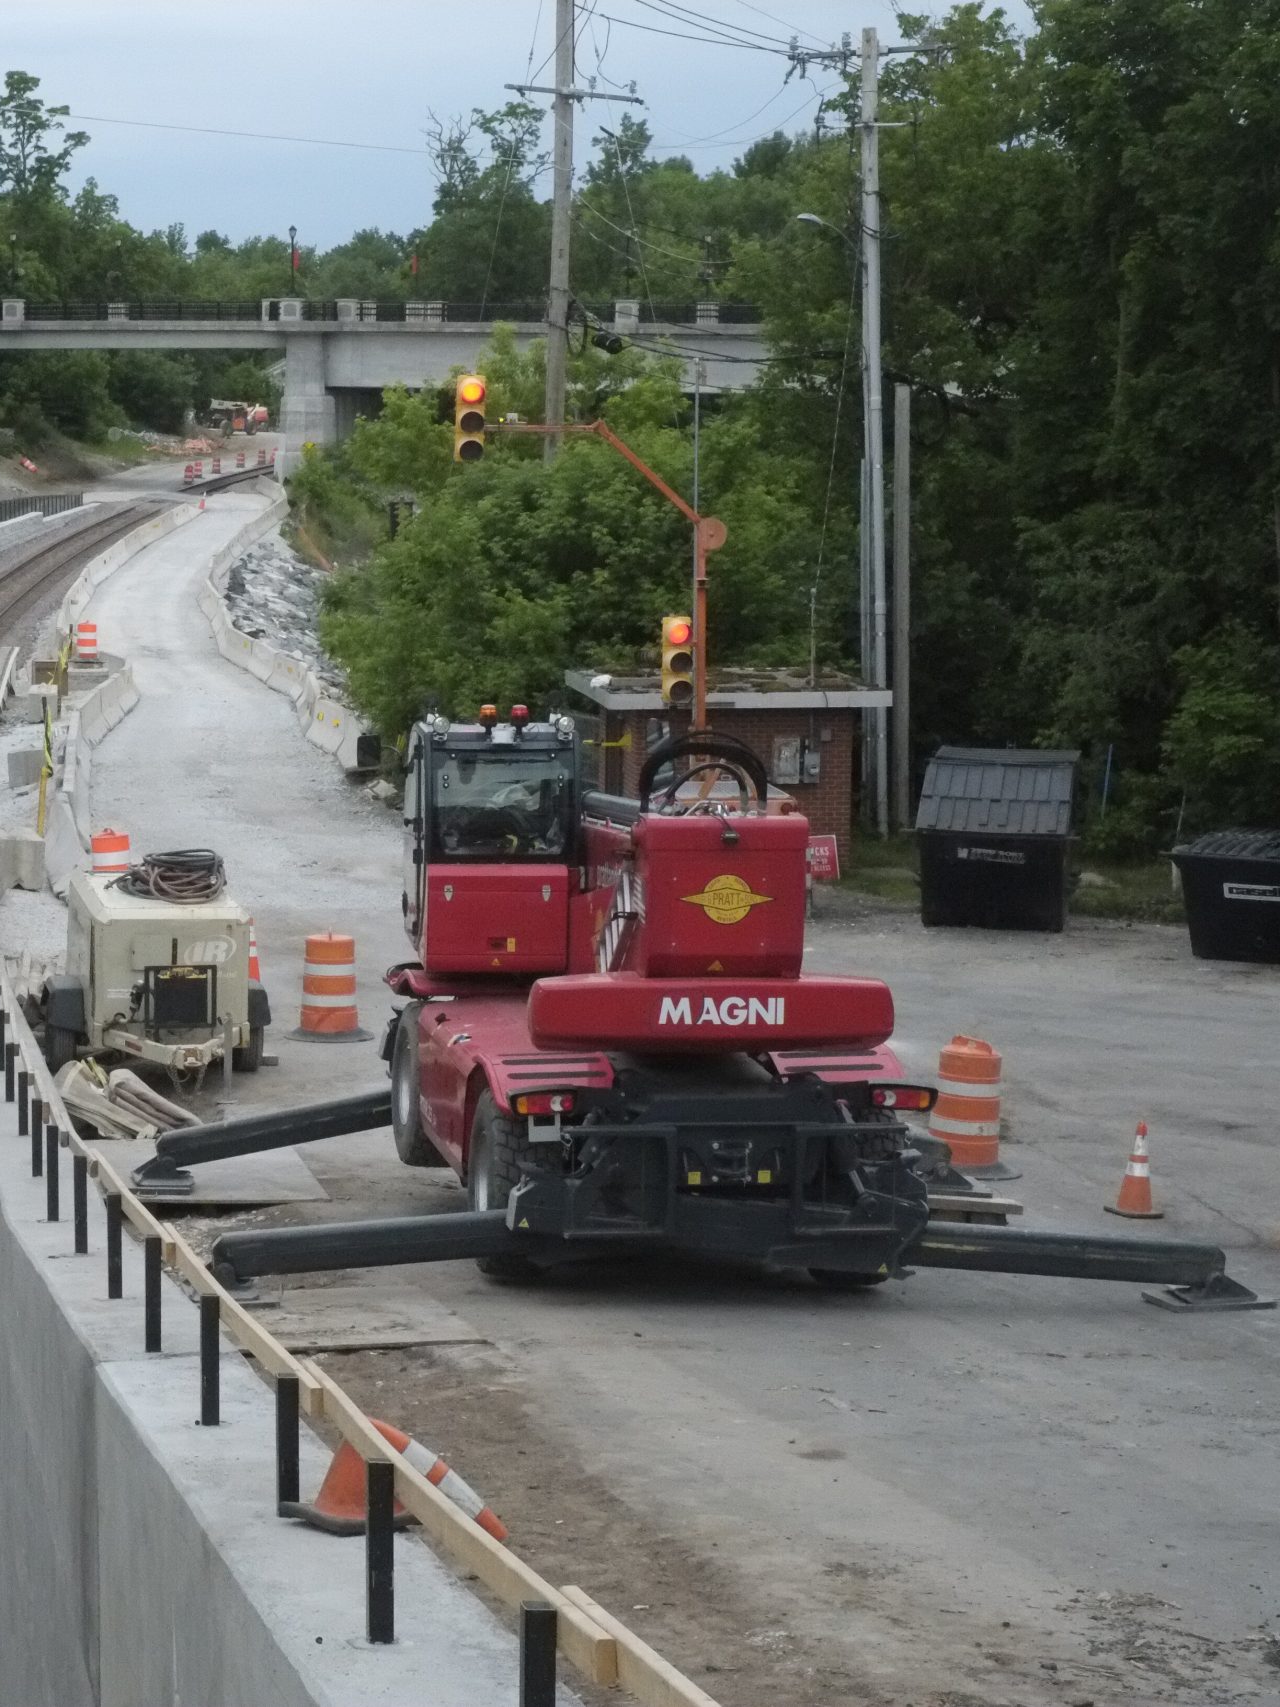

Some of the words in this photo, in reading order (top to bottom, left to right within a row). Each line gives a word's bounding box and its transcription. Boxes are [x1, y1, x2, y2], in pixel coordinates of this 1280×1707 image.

[712, 892, 741, 906] PRATT
[192, 940, 228, 962] IR
[658, 996, 785, 1026] MAGNI
